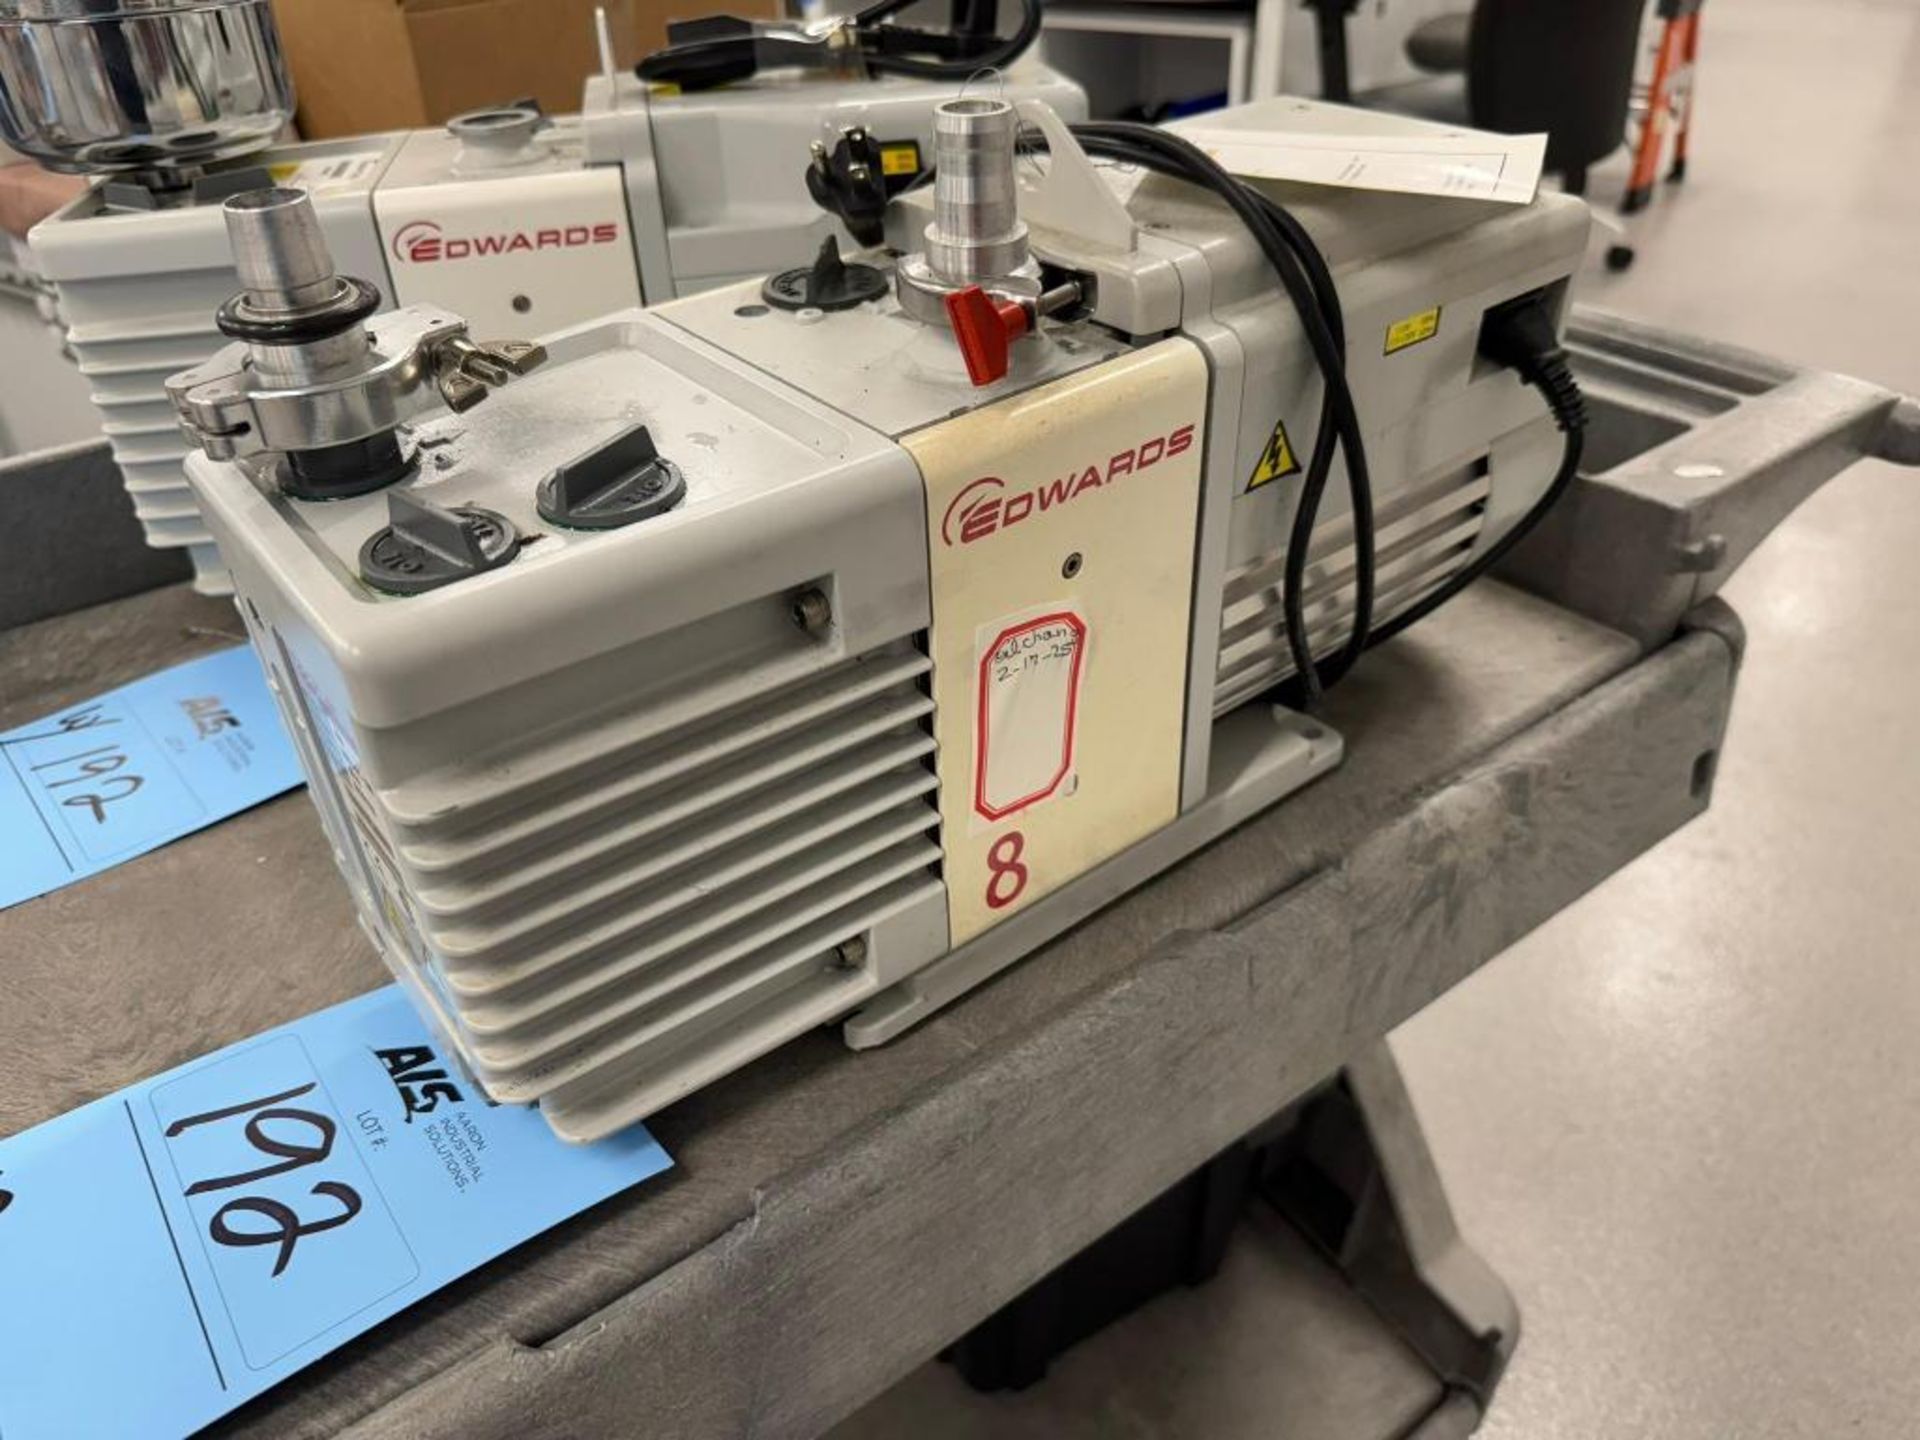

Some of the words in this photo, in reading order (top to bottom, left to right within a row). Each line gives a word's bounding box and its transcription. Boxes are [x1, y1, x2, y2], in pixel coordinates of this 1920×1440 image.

[405, 224, 617, 264] EDWARDS
[958, 423, 1196, 545] EDWARDS
[30, 744, 145, 825] 192
[986, 831, 1027, 909] 8
[357, 1109, 384, 1136] LOT
[441, 1117, 484, 1183] INDUSTRIAL
[456, 1111, 487, 1152] AARON
[165, 1082, 362, 1278] 192
